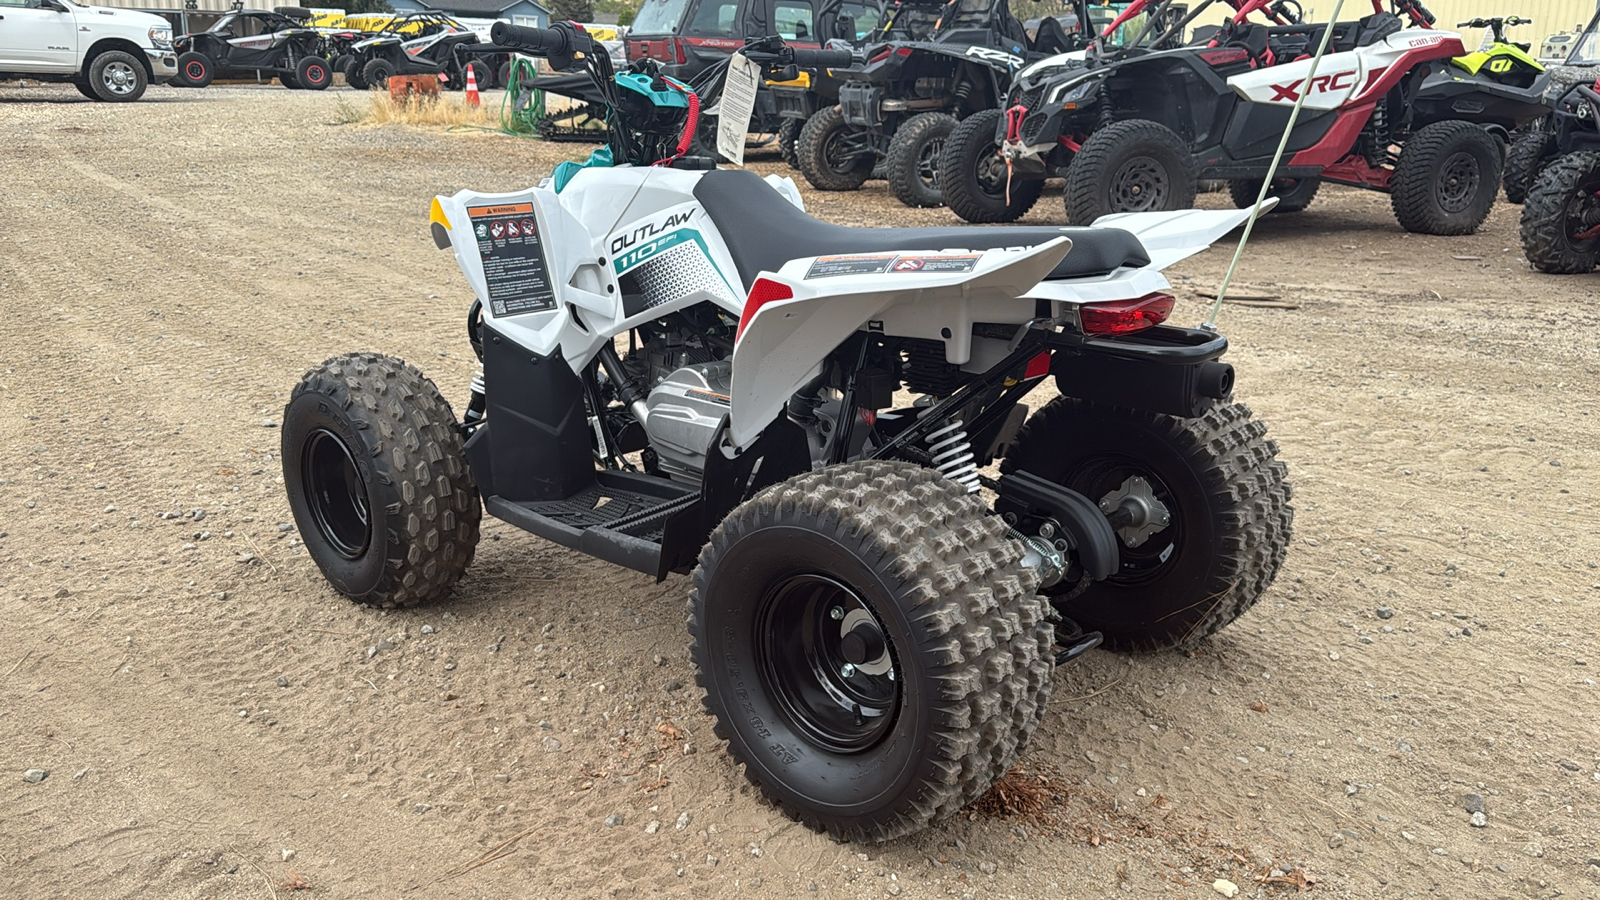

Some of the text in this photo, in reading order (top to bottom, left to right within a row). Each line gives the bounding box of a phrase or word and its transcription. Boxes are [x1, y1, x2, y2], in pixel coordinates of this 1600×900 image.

[965, 46, 1024, 69] RZR
[1490, 58, 1513, 73] 01
[1269, 70, 1356, 101] XRC
[611, 208, 696, 255] OUTLAW
[620, 243, 657, 268] 110
[769, 743, 799, 765] AT
